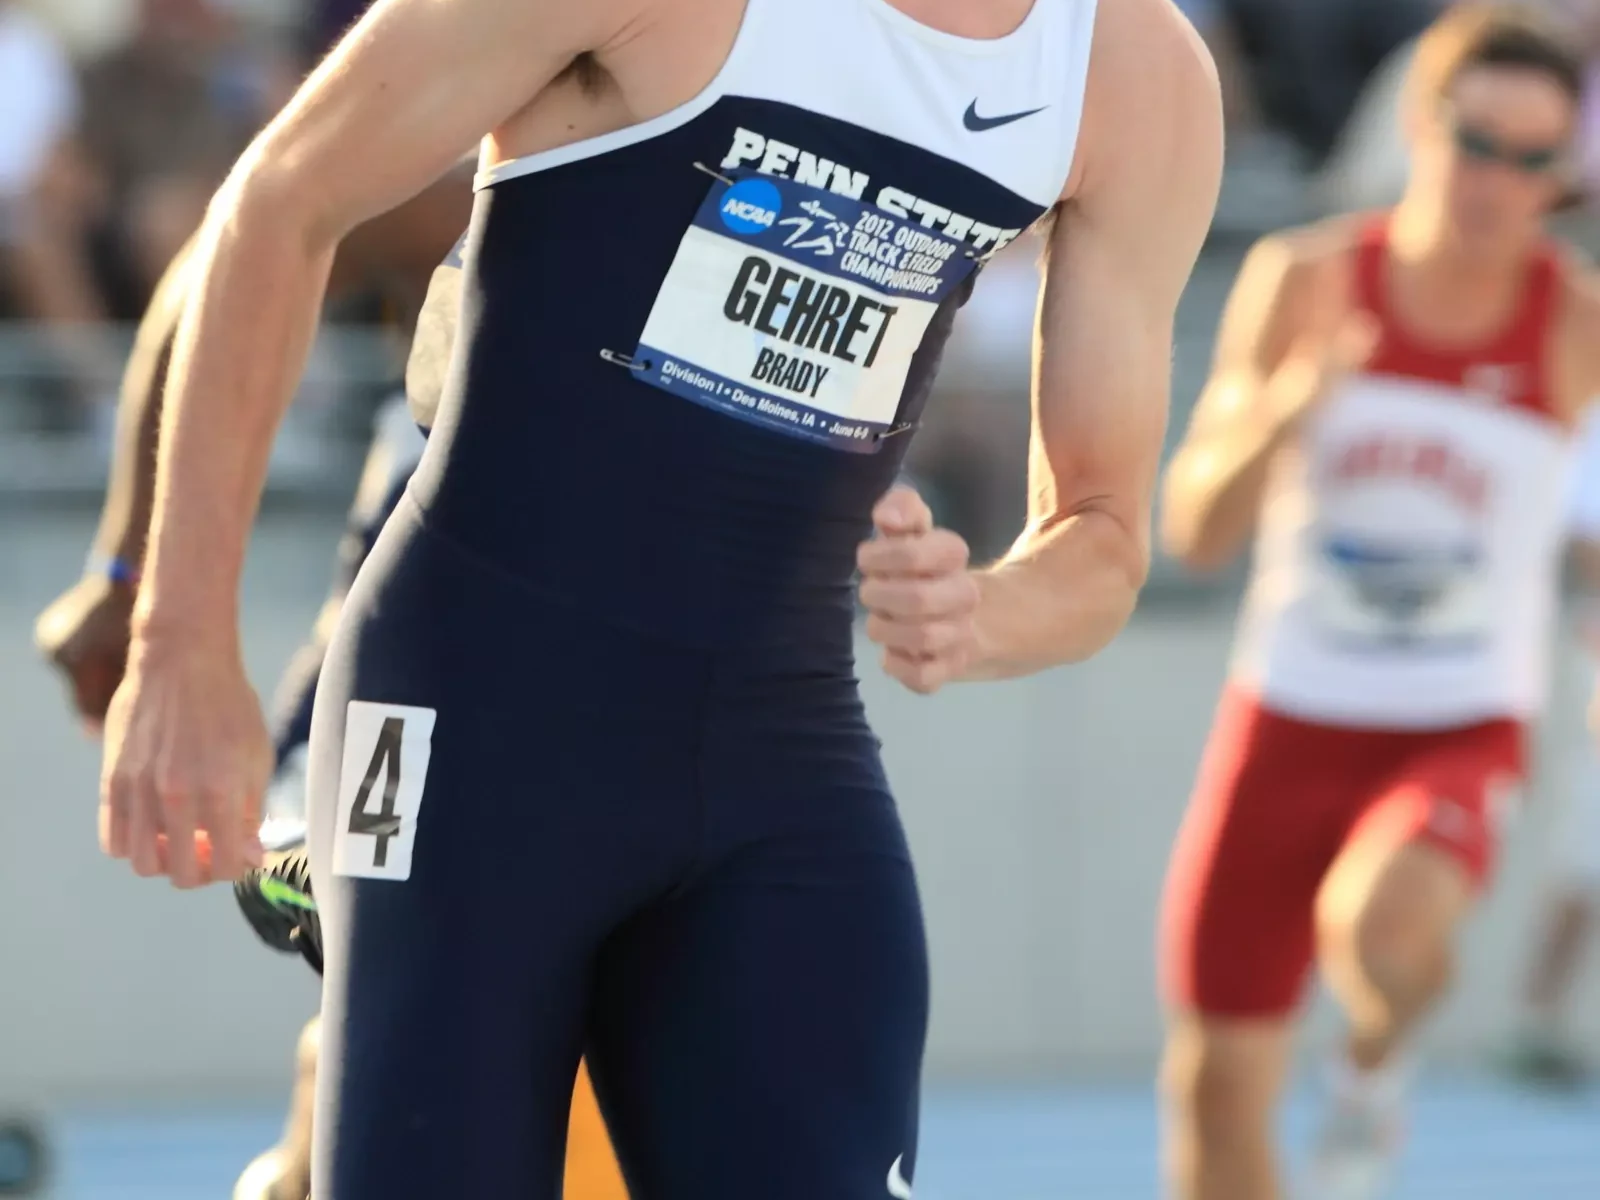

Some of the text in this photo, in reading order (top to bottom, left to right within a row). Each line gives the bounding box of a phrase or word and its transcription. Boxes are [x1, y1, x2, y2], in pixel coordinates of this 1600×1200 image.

[720, 127, 870, 201] PENN
[722, 198, 777, 228] NCAA
[855, 211, 957, 261] 2012 OUTDOOR
[849, 230, 902, 267] TRACK
[723, 255, 899, 369] GEHRET
[661, 360, 715, 392] Division
[731, 388, 757, 408] Des
[757, 398, 800, 423] Moines,
[801, 412, 816, 427] IA
[829, 422, 854, 437] June
[751, 347, 830, 398] BRADY
[348, 717, 405, 868] 4
